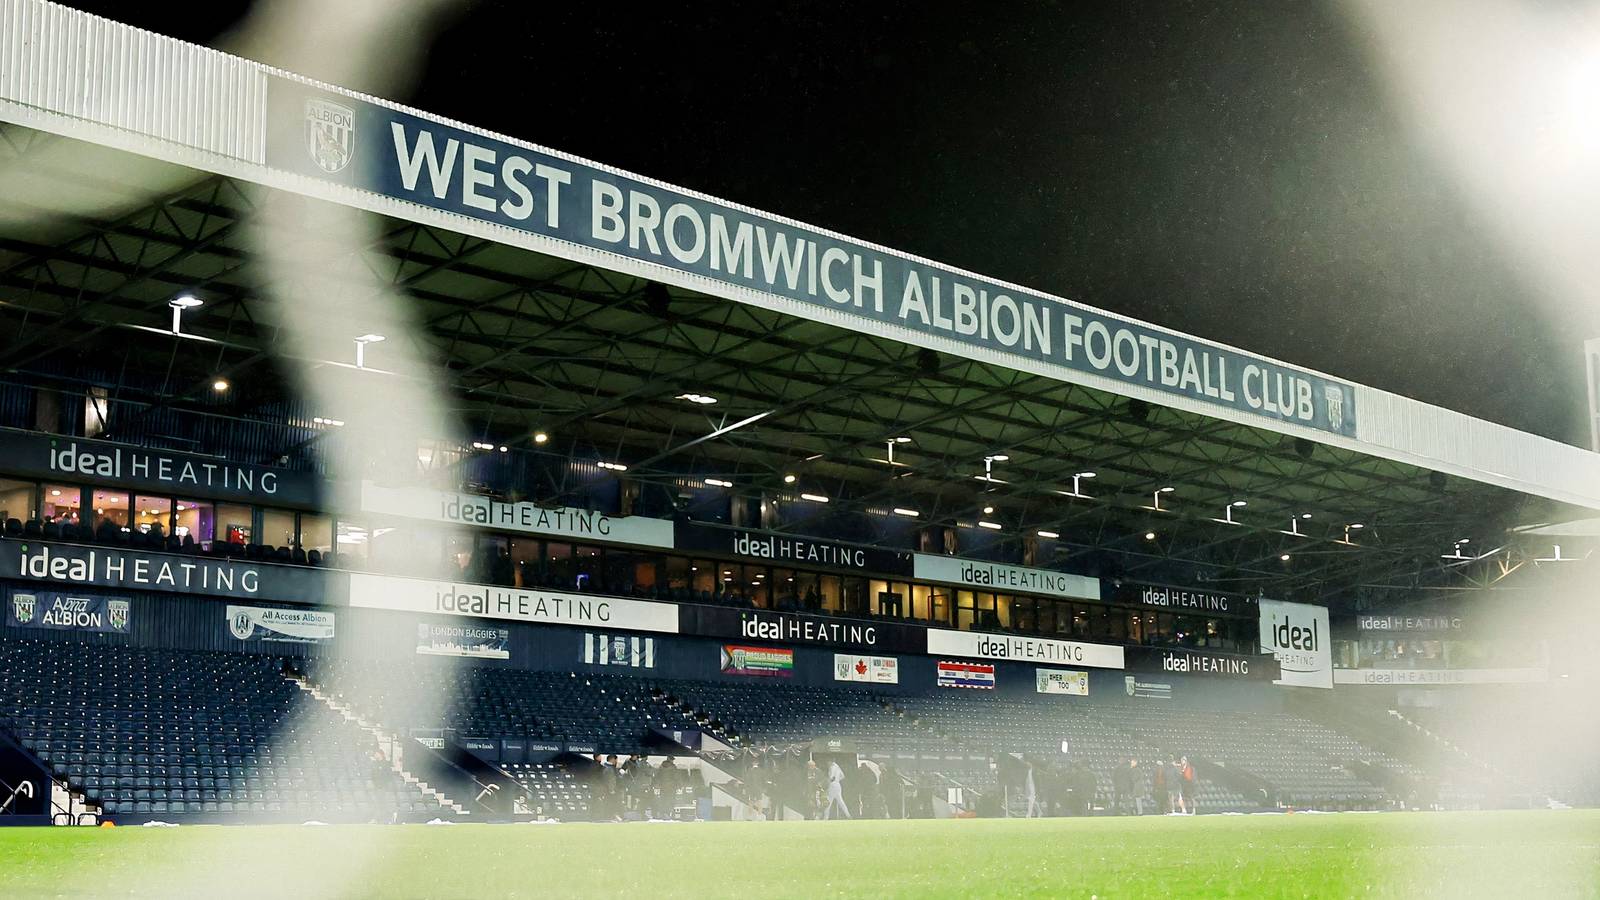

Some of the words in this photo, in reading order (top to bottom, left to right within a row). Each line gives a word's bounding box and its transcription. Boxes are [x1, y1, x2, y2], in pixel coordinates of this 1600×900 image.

[309, 107, 352, 129] ALBION
[391, 121, 572, 229] WEST
[592, 179, 884, 313] BROMWICH
[899, 269, 1051, 355] ALBION
[1064, 313, 1235, 402] FOOTBALL
[1242, 363, 1314, 421] CLUB
[50, 440, 121, 478] ideal
[132, 454, 278, 494] HEATING
[441, 495, 493, 524] ideal
[501, 500, 610, 535] HEATING
[734, 531, 774, 559] ideal
[780, 542, 865, 567] HEATING
[20, 545, 95, 582] ideal
[106, 556, 259, 593] HEATING
[961, 561, 994, 585] ideal
[998, 569, 1066, 592] HEATING
[436, 586, 489, 615] ideal
[498, 592, 610, 622] HEATING
[1143, 585, 1169, 607] ideal
[1172, 592, 1228, 611] HEATING
[42, 610, 101, 628] ALBION
[262, 611, 273, 619] All
[275, 611, 301, 621] Access
[302, 613, 327, 623] Albion
[742, 613, 783, 640] ideal
[789, 621, 876, 645] HEATING
[1362, 616, 1391, 630] ideal
[1395, 618, 1462, 629] HEATING
[432, 626, 464, 638] LONDON
[465, 629, 497, 640] BAGGIES
[1272, 613, 1319, 652] ideal
[978, 634, 1010, 658] ideal
[1014, 640, 1083, 662] HEATING
[1279, 653, 1314, 667] HEATING
[1164, 652, 1190, 672] ideal
[1192, 657, 1248, 675] HEATING
[1365, 671, 1394, 683] ideal
